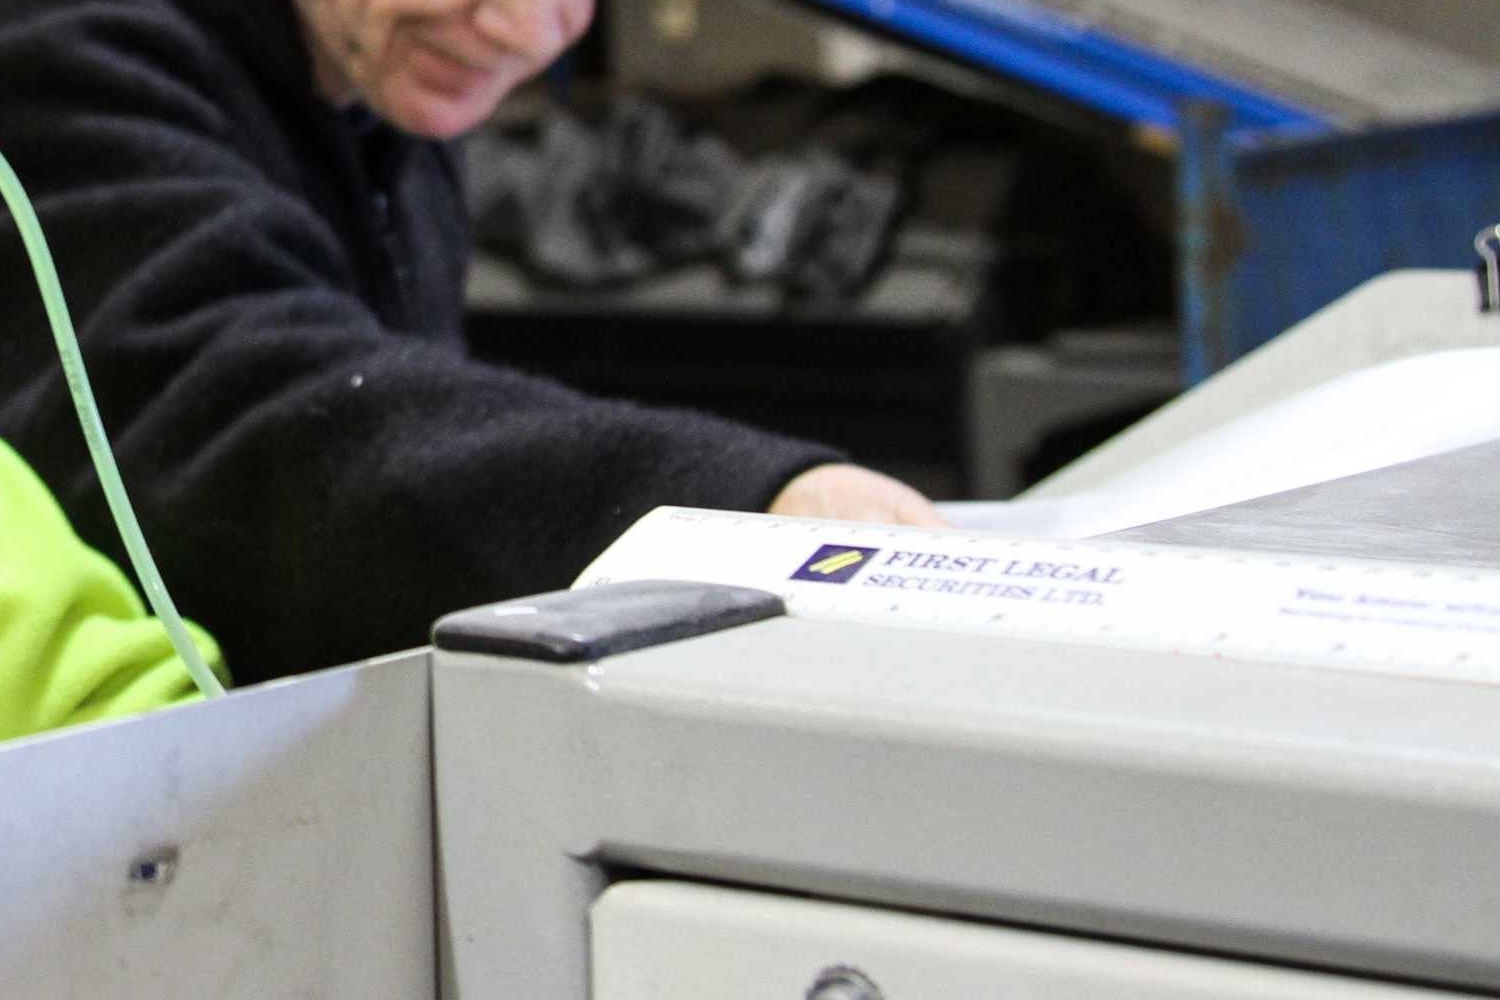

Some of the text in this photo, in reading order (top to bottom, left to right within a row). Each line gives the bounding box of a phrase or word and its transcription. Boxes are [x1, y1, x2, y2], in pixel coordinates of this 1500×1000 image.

[882, 550, 1125, 585] FIRST LEGAL
[862, 572, 1036, 601] SECURITIES
